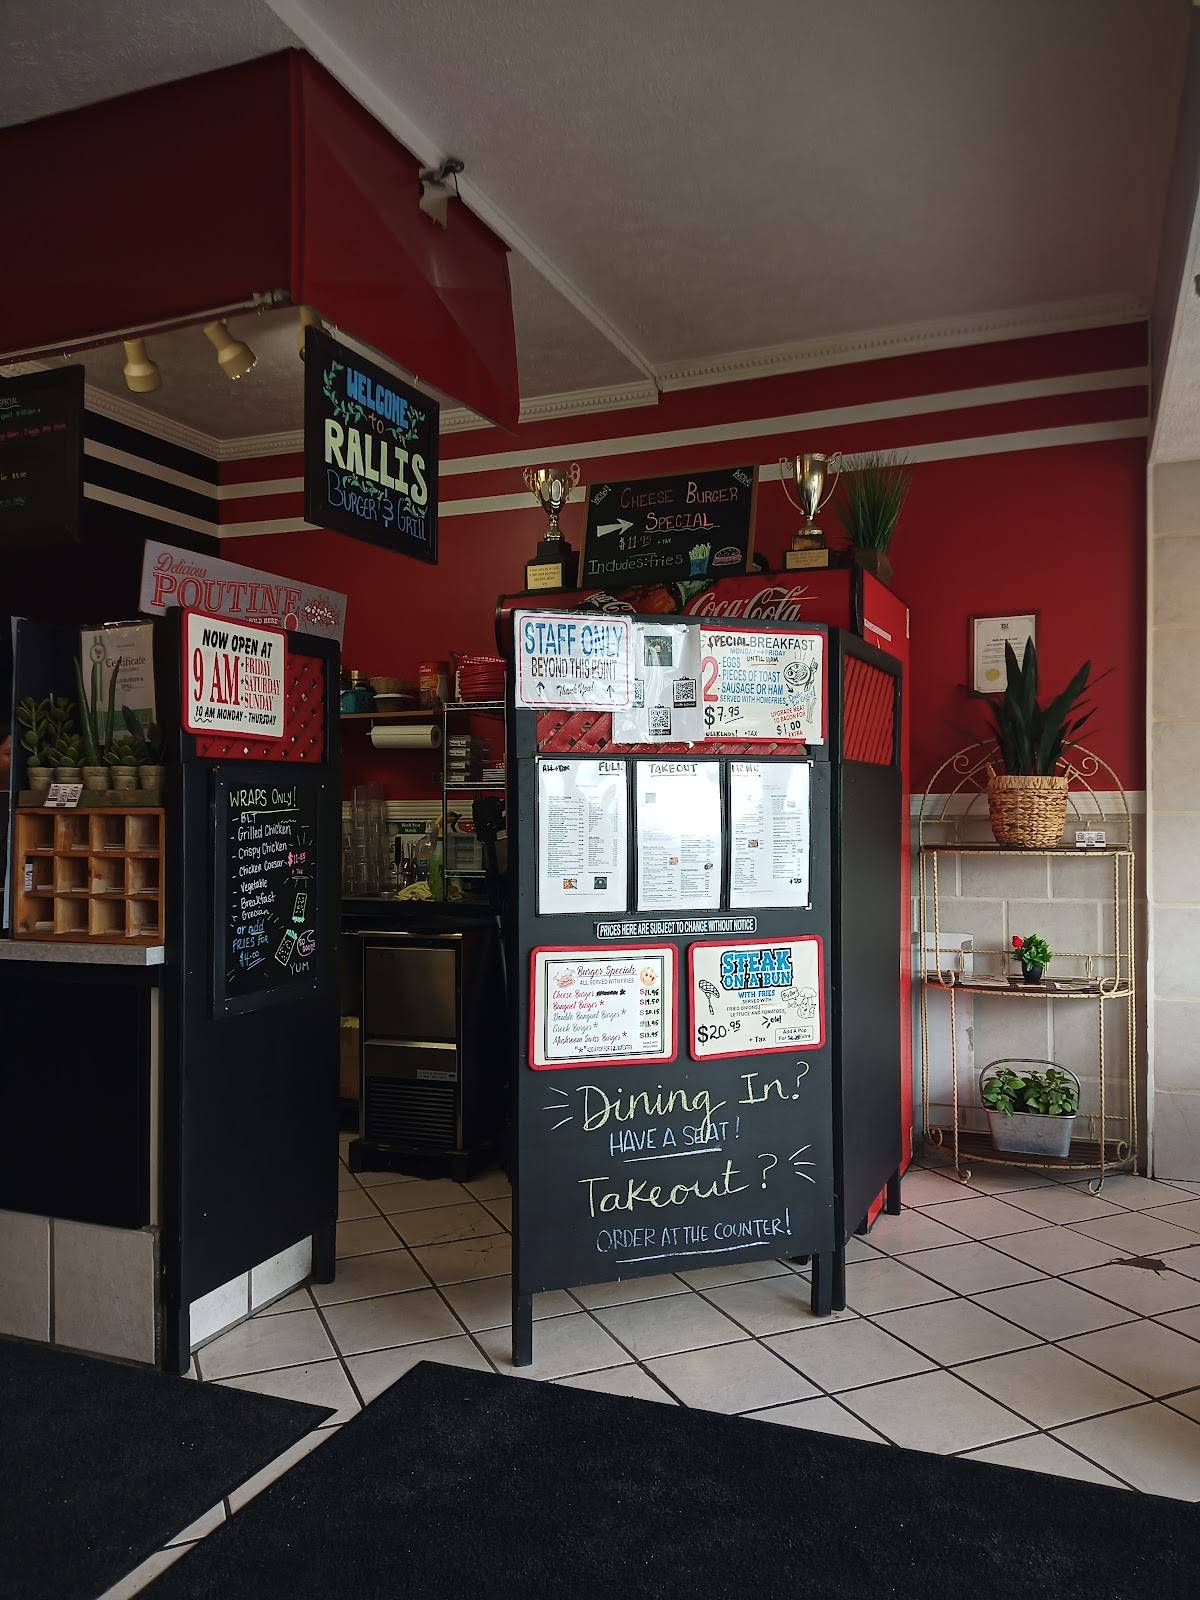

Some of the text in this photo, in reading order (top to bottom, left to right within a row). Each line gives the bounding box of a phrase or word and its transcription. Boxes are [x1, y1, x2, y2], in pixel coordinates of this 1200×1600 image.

[346, 366, 409, 429] WELCOME
[369, 413, 384, 434] to
[325, 418, 428, 507] RALLIS
[620, 480, 738, 509] CHEESE BURGER
[327, 469, 377, 521] BURGER
[397, 498, 427, 541] GRILL
[645, 511, 714, 531] SPECIAL
[154, 553, 208, 577] Delicious
[151, 571, 302, 616] POUTINE
[689, 585, 819, 622] Coca-Cola
[202, 629, 273, 659] NOW OPEN AT
[525, 622, 623, 657] STAFF ONLY
[707, 635, 815, 651] SPECIAL BREAKFAST
[245, 656, 272, 677] FRIDAY
[531, 656, 617, 681] BEYOND THIS POINT
[722, 656, 741, 669] EGGS
[193, 648, 240, 706] 9 AM
[244, 674, 281, 696] SATURDAY
[702, 656, 719, 702] 2
[722, 668, 781, 683] PIECES OF TOAST
[719, 694, 741, 703] SERVED
[741, 695, 756, 704] WITH
[721, 682, 784, 696] SAUSAGE OR HAM
[244, 693, 274, 712] SUNDAY
[771, 707, 793, 717] UPGRADE
[195, 706, 277, 726] 10 AM MONDAY THURSDAY
[704, 705, 740, 729] $7.95
[649, 763, 698, 774] TAKEOUT
[230, 786, 296, 807] WRAPS ONLY!
[241, 812, 256, 824] BLT
[237, 822, 291, 841] Grilled Chicken
[238, 841, 287, 860] Crispy Chicken
[239, 864, 261, 877] Chicken
[240, 878, 268, 895] Vegetable
[240, 891, 276, 909] Breakfast
[236, 918, 265, 935] or add
[600, 918, 754, 936] PRICES HERE ARE SUBJECT TO CHANGE WITHOUT NOTICE
[232, 936, 255, 953] FRIES
[239, 951, 259, 967] $4.00
[289, 961, 309, 976] YUM
[722, 950, 791, 975] STEAK
[606, 964, 637, 978] Specials
[724, 972, 791, 988] ON A BUN
[553, 990, 572, 999] Cheese
[576, 1061, 810, 1143] Dining In?
[609, 1127, 657, 1156] HAVE
[662, 1127, 677, 1147] A
[596, 1207, 792, 1252] ORDER AT THE COUNTER!
